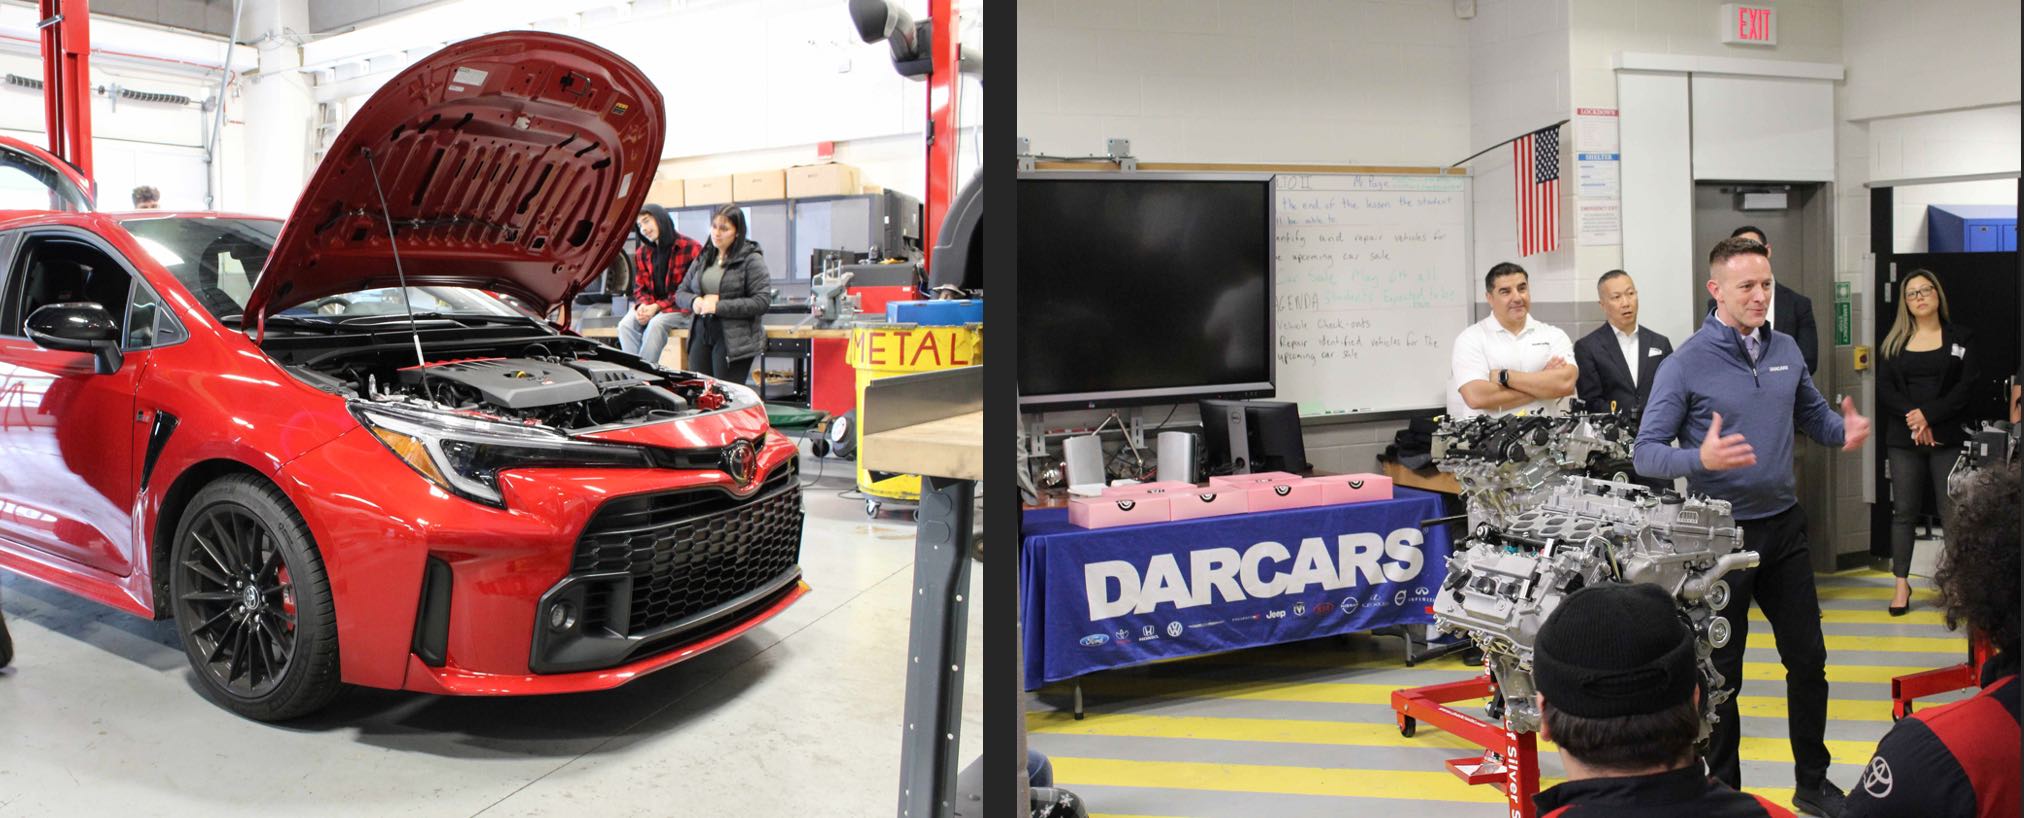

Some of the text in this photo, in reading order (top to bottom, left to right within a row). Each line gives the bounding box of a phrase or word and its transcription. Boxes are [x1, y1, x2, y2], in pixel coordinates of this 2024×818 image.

[1738, 7, 1771, 41] EXIT
[1302, 198, 1319, 209] end
[1354, 234, 1383, 245] repair
[1370, 249, 1391, 260] sale
[853, 330, 968, 366] METAL
[1279, 335, 1308, 349] Repair
[1084, 527, 1425, 622] DARCARS
[1266, 610, 1286, 619] Jeep
[1507, 745, 1518, 804] Silver
